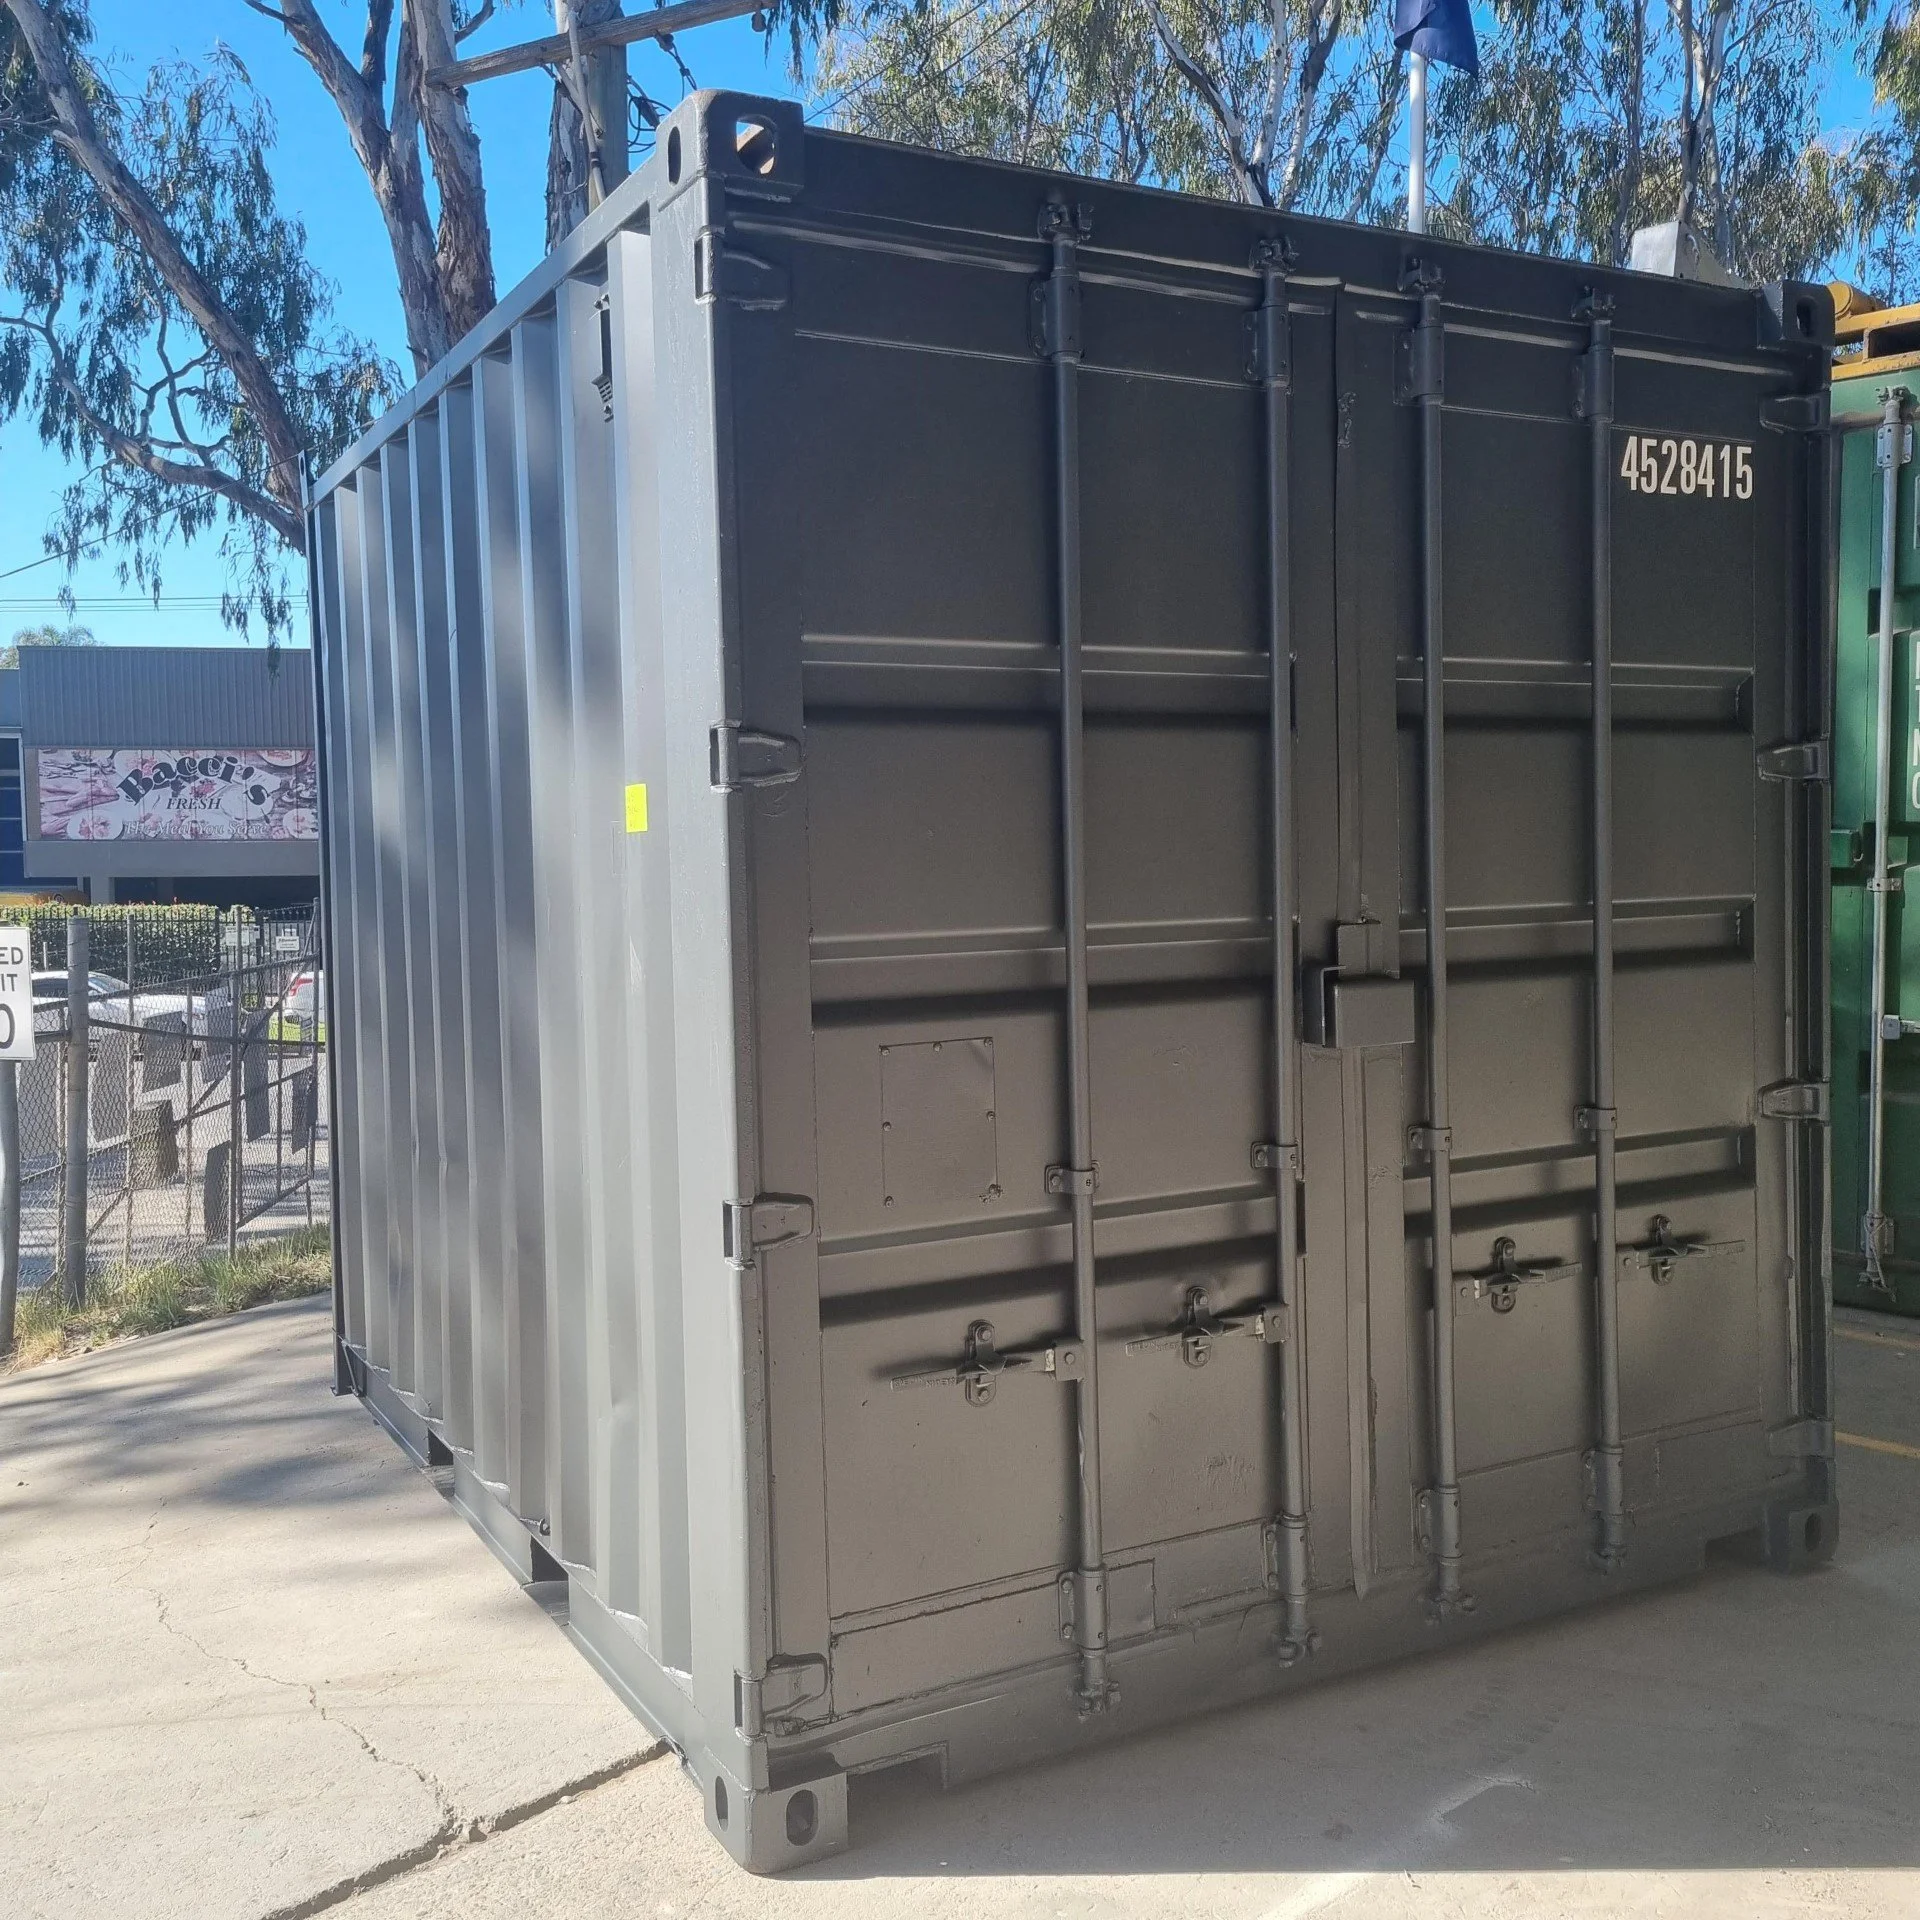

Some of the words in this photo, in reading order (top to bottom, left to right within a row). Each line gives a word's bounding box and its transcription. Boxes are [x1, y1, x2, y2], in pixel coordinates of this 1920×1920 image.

[1621, 435, 1753, 500] 4528415
[116, 755, 270, 806] Bacci's
[166, 797, 222, 810] FRESH
[197, 821, 225, 836] You
[228, 820, 267, 836] Serve
